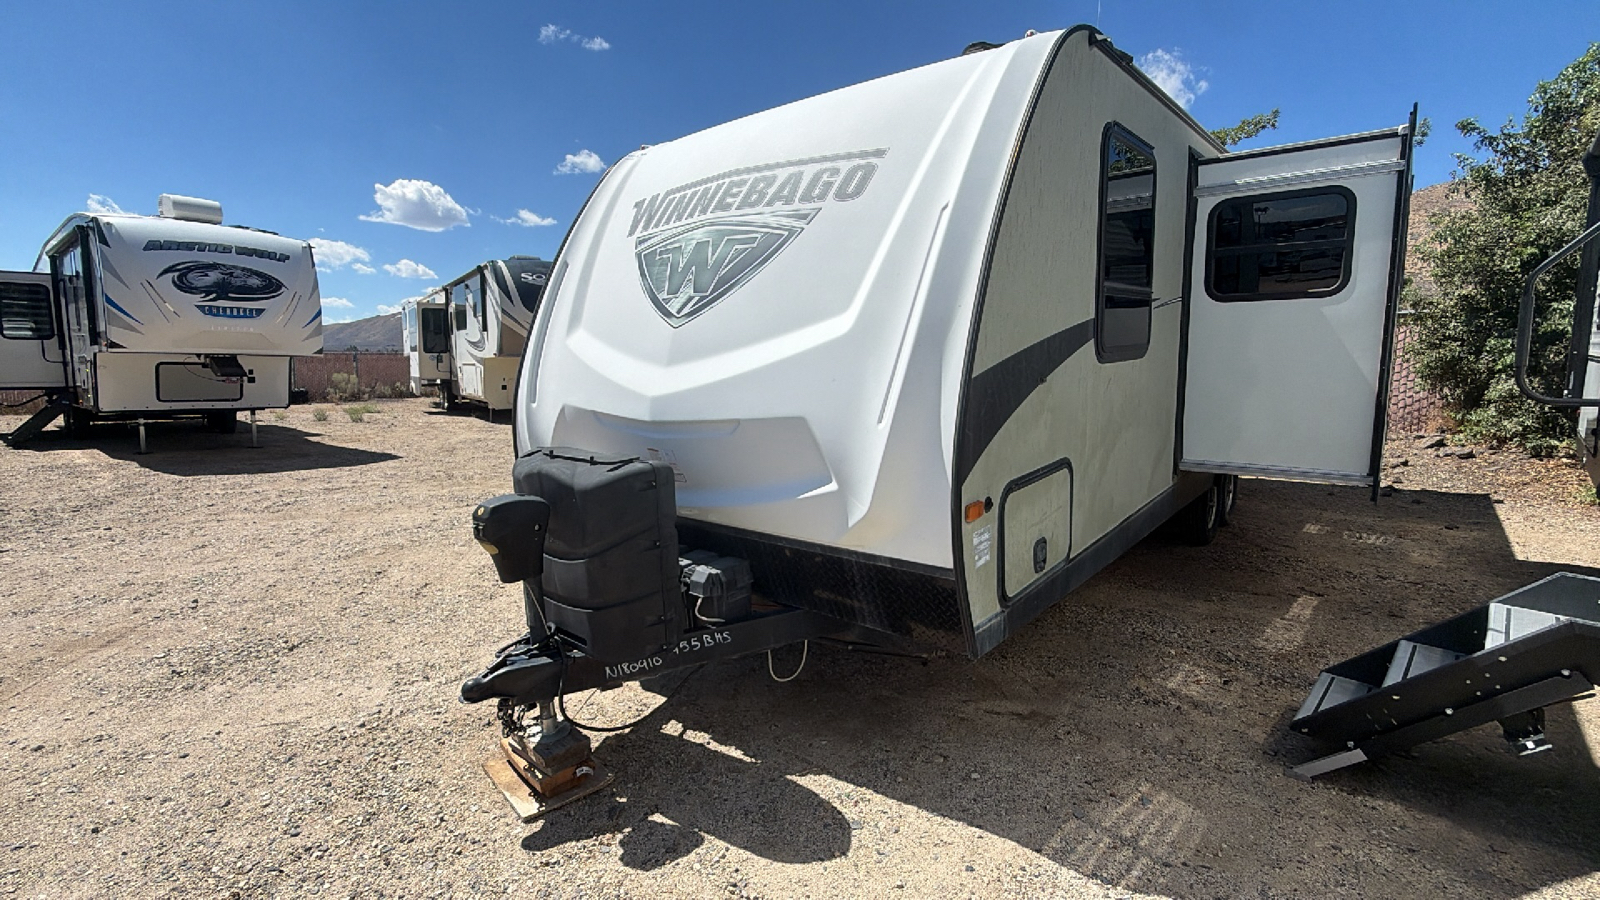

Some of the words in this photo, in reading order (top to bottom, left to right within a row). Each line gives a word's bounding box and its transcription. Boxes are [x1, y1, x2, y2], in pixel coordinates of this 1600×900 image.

[627, 161, 879, 238] WINNEBAGO
[142, 240, 232, 253] ARCTIC
[235, 245, 290, 263] WOLF
[656, 237, 762, 299] W
[520, 272, 546, 281] SO
